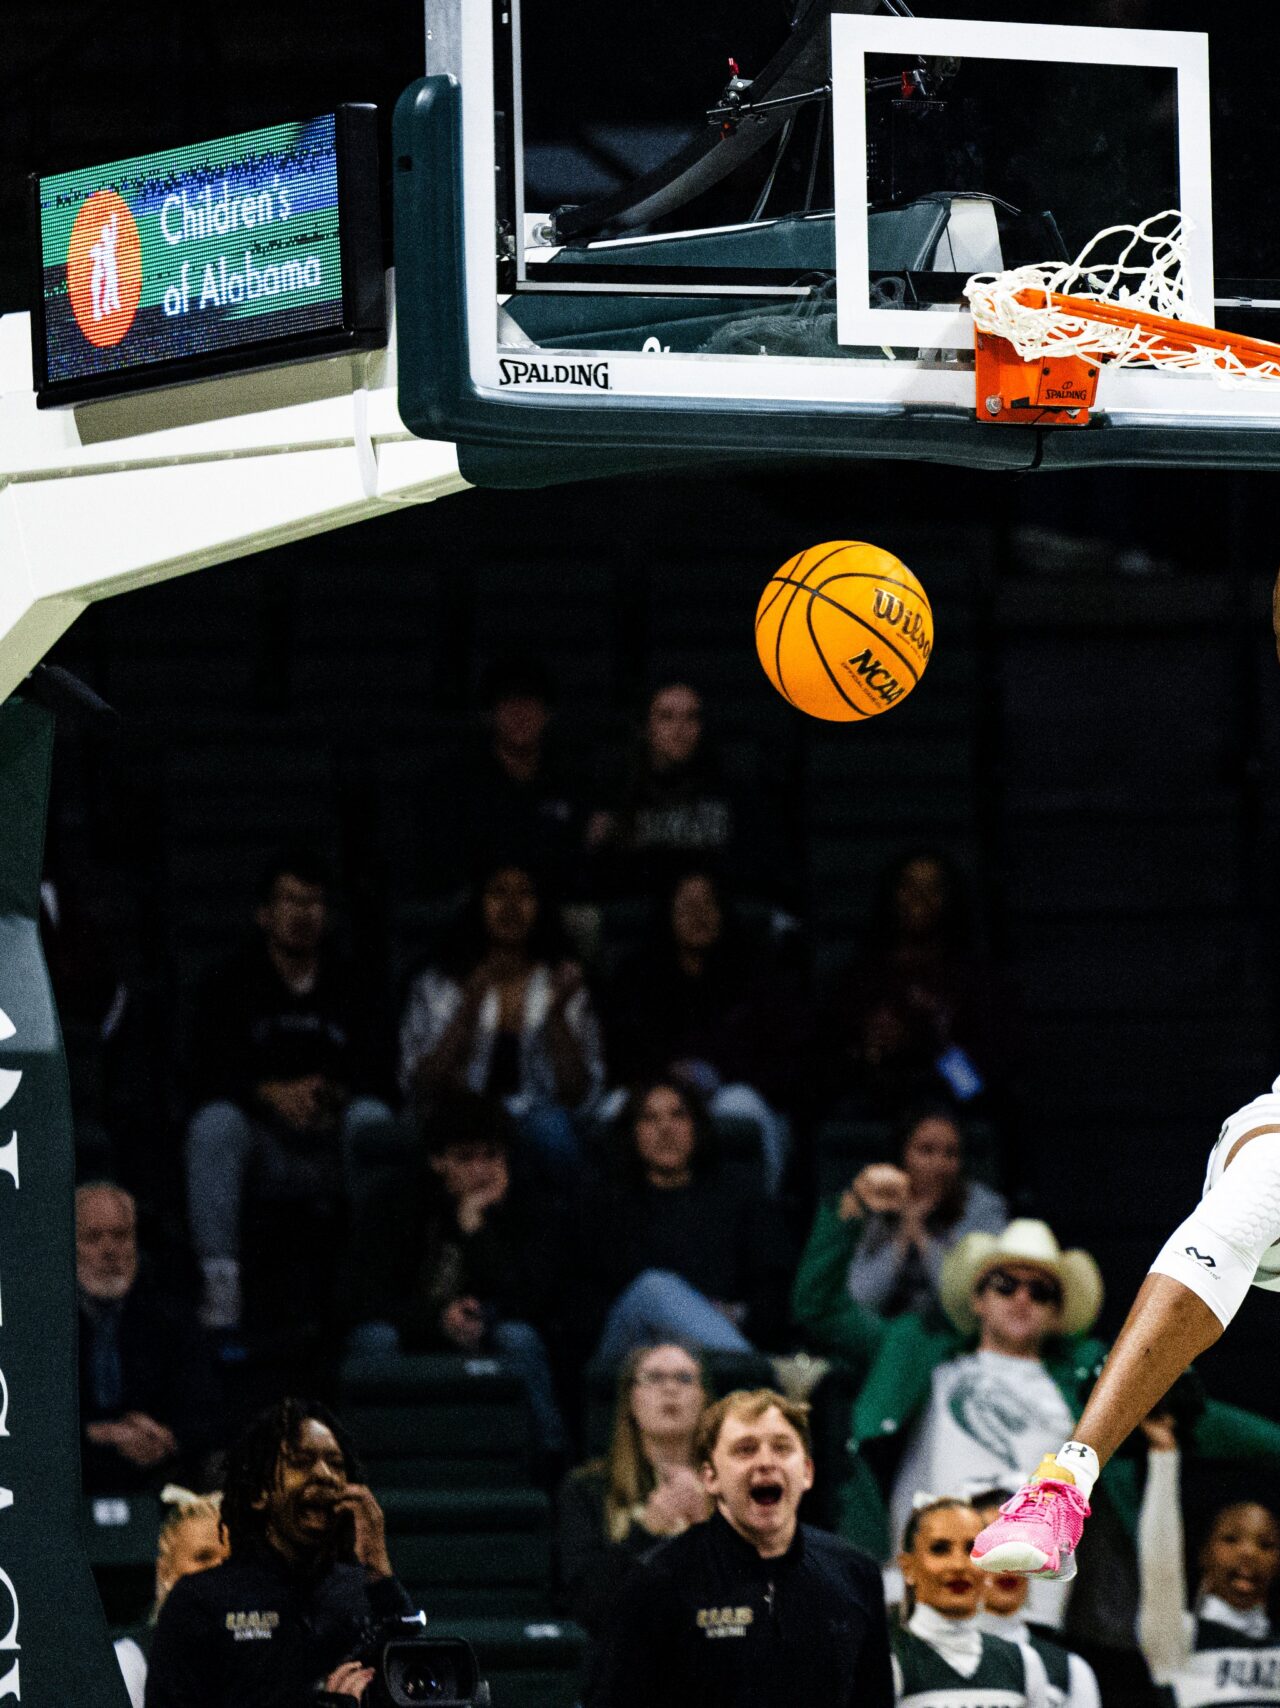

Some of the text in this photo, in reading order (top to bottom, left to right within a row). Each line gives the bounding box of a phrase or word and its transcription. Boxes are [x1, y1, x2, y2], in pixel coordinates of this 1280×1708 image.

[160, 174, 291, 245] Children's
[164, 250, 321, 316] of Alabama
[499, 358, 609, 390] SPALDING
[1045, 388, 1087, 401] SPALDING
[873, 588, 930, 663] Wilso
[848, 648, 905, 705] NCAA
